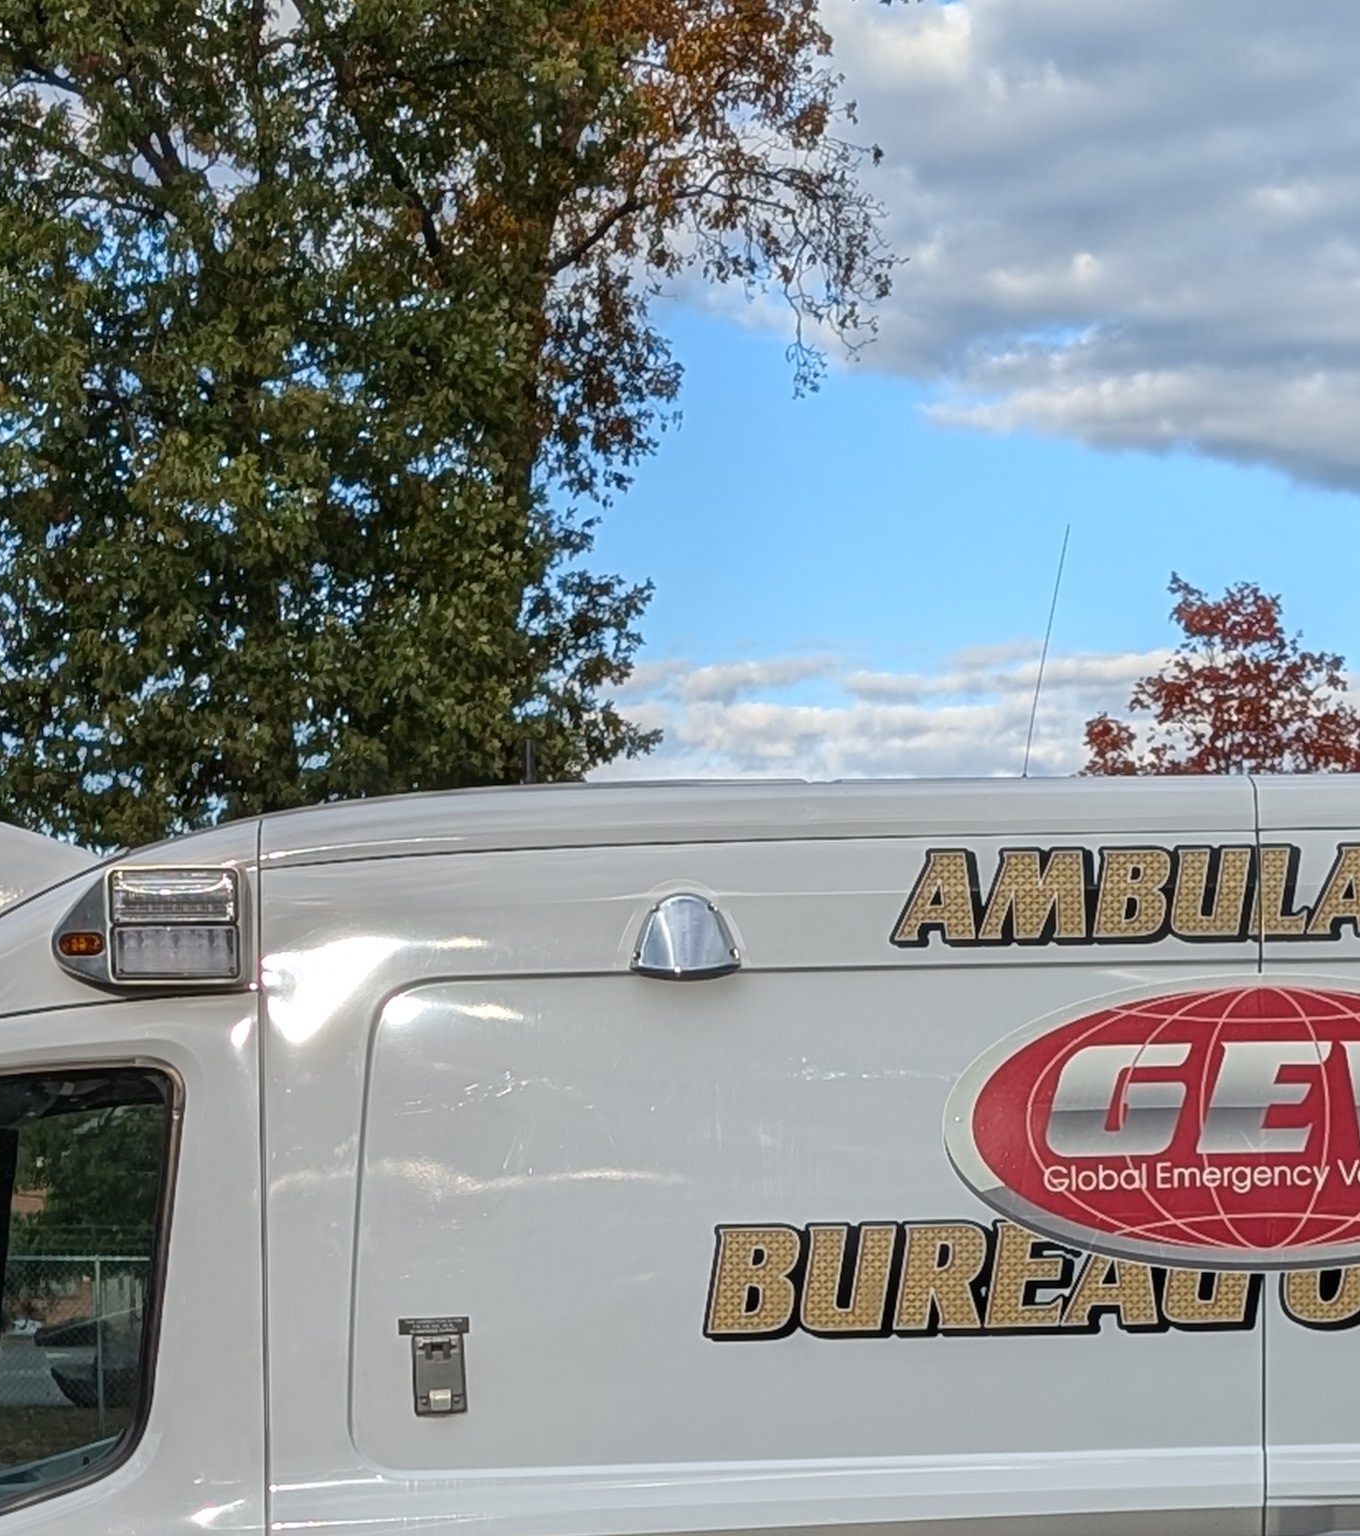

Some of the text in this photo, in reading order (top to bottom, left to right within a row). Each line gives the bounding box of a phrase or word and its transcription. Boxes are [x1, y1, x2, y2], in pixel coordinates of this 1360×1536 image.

[1043, 1162, 1147, 1192] Global
[1156, 1161, 1330, 1194] Emergency
[703, 1219, 1260, 1341] BUREAU
